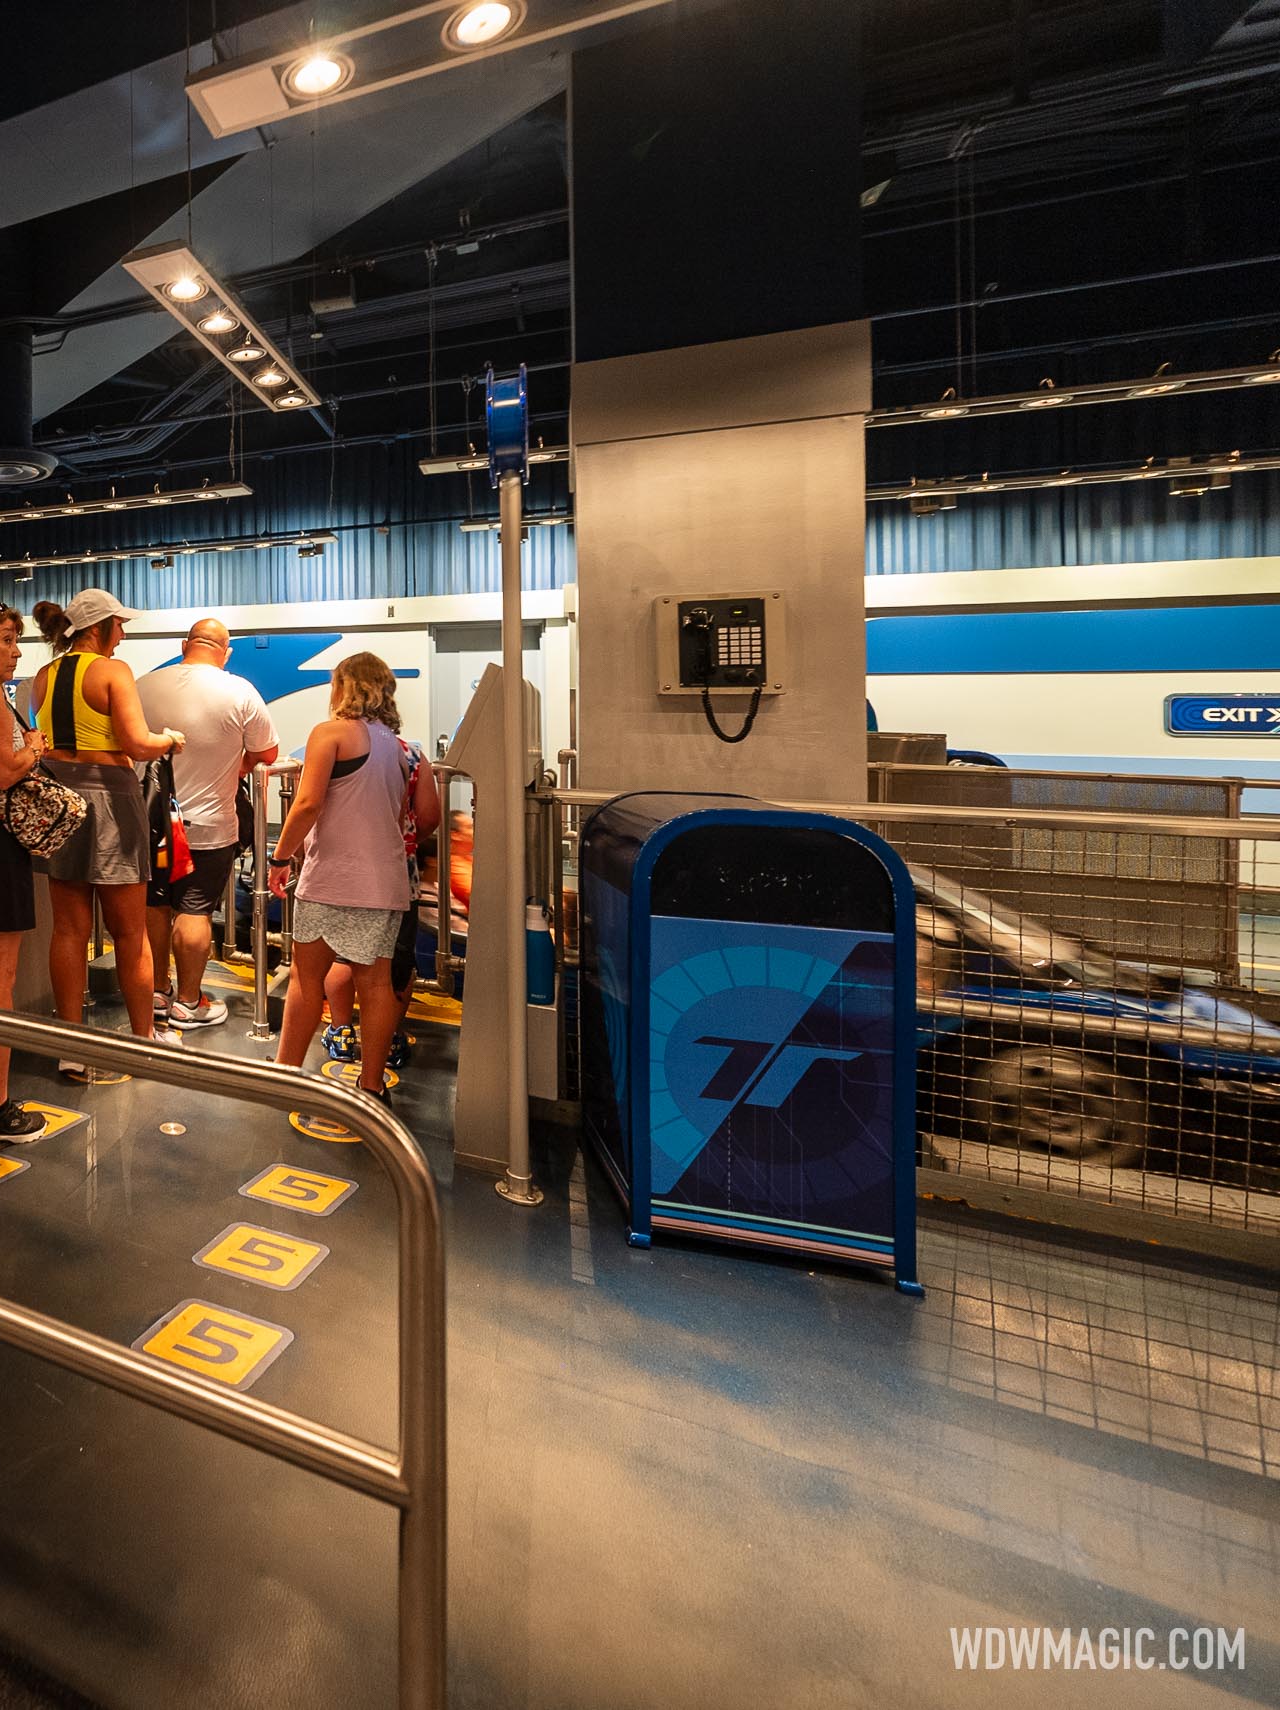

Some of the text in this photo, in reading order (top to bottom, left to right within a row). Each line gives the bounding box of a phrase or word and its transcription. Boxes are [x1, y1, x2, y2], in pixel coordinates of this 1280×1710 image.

[1202, 707, 1264, 722] EXIT
[269, 1175, 328, 1201] 5
[228, 1237, 296, 1272] 5
[172, 1317, 254, 1365] 5
